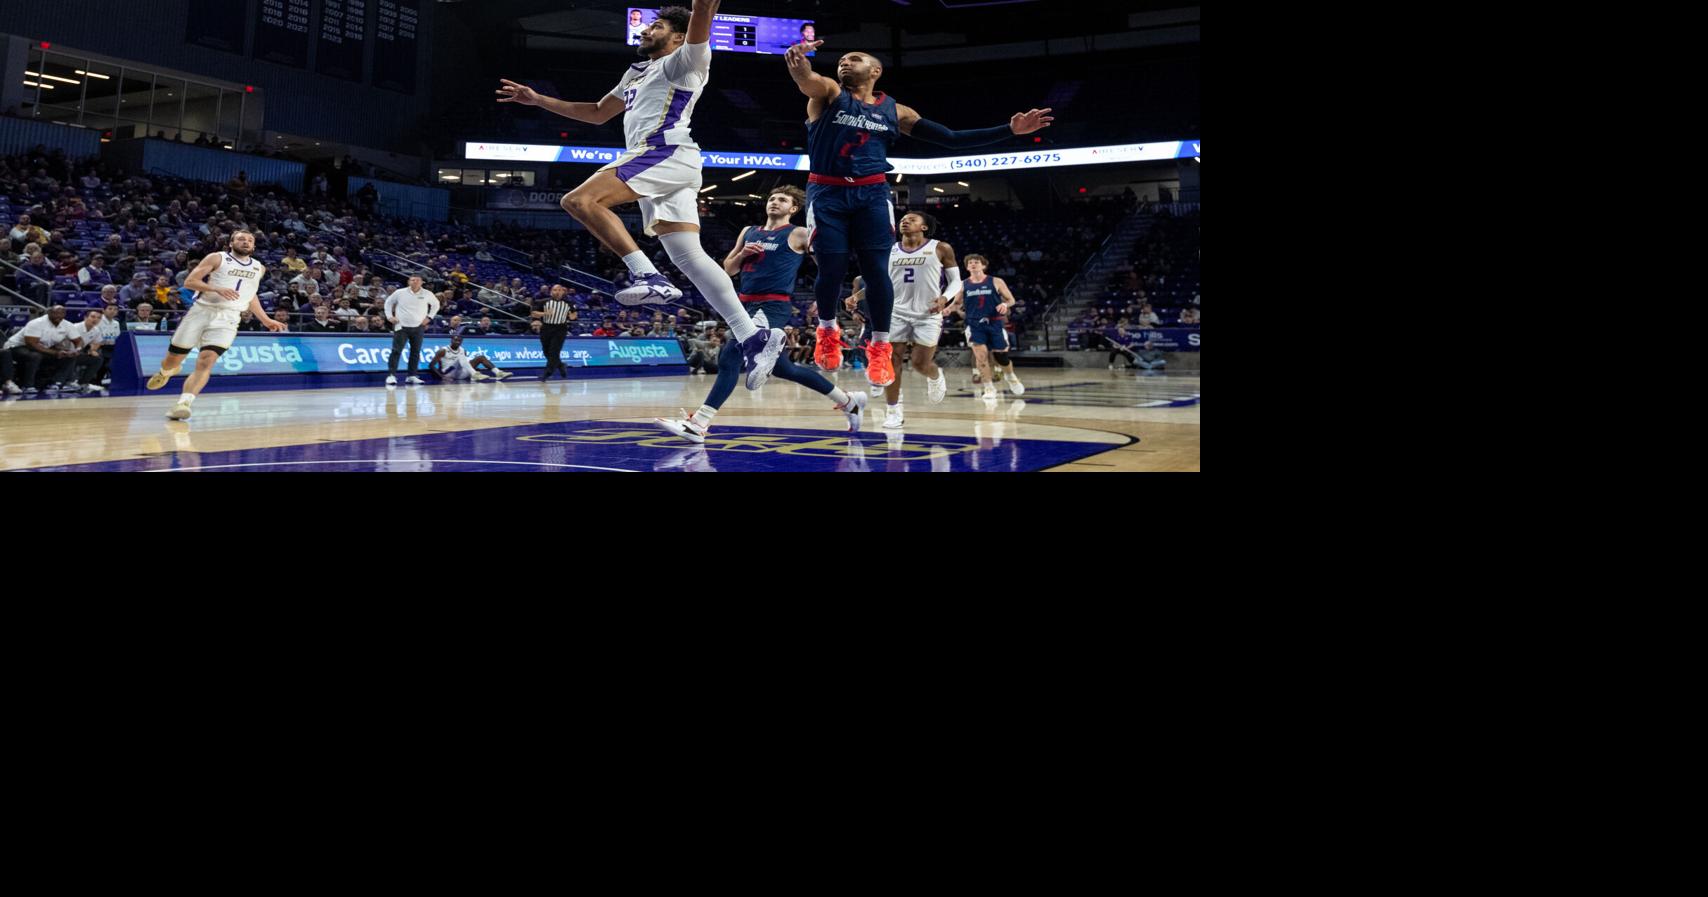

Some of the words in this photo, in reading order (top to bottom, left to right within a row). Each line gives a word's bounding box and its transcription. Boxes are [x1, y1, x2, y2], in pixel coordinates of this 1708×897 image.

[571, 149, 613, 160] We're
[709, 154, 741, 165] Your
[743, 155, 786, 167] HVAC.
[950, 158, 987, 170] (540)
[991, 153, 1061, 167] 227-6975
[892, 257, 926, 267] JMU
[228, 268, 256, 279] JMU
[903, 268, 914, 283] 2
[235, 279, 242, 291] 1
[184, 343, 302, 371] gusta
[608, 340, 669, 363] Augusta
